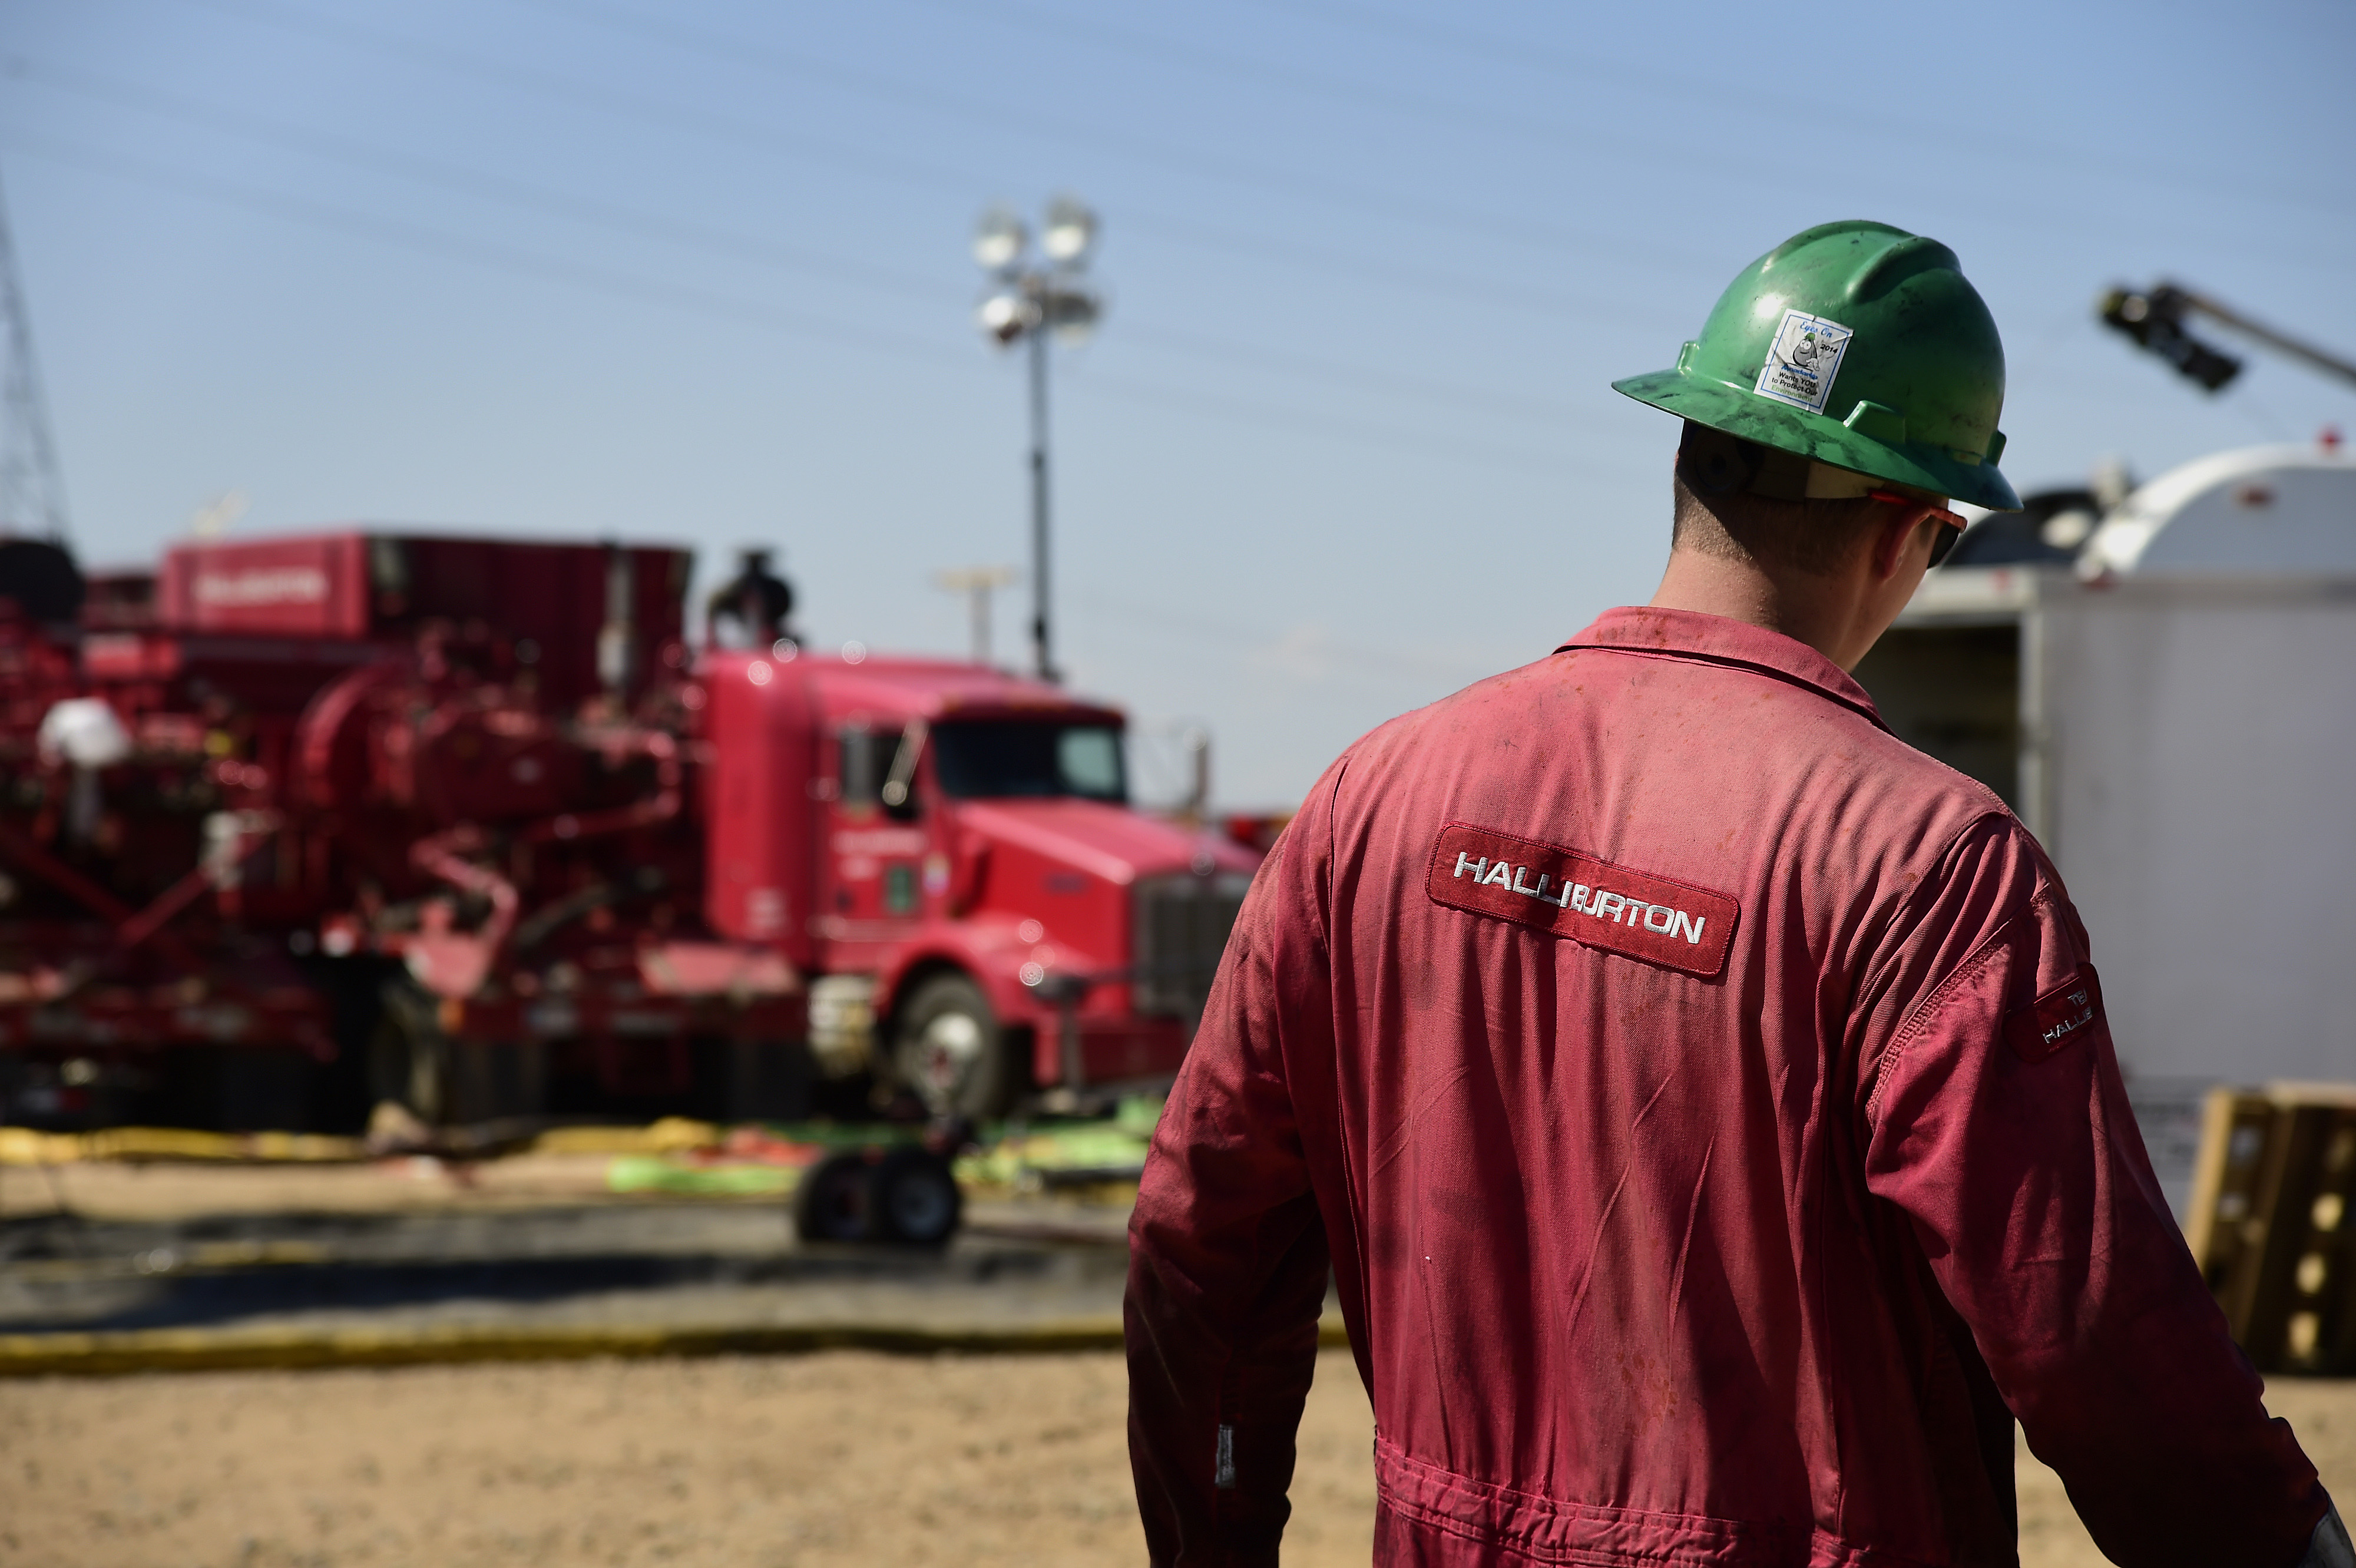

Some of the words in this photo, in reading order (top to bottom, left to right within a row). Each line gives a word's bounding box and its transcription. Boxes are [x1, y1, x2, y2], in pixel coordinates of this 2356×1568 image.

[1800, 321, 1818, 333] Eyes
[1821, 328, 1832, 338] On
[1820, 344, 1838, 354] 2014
[1779, 372, 1799, 383] Wants
[1801, 378, 1816, 388] YOU
[1780, 379, 1804, 393] Protect
[1805, 387, 1818, 396] Our
[1771, 385, 1812, 403] Environment
[1453, 851, 1706, 944] HALLIBURTON
